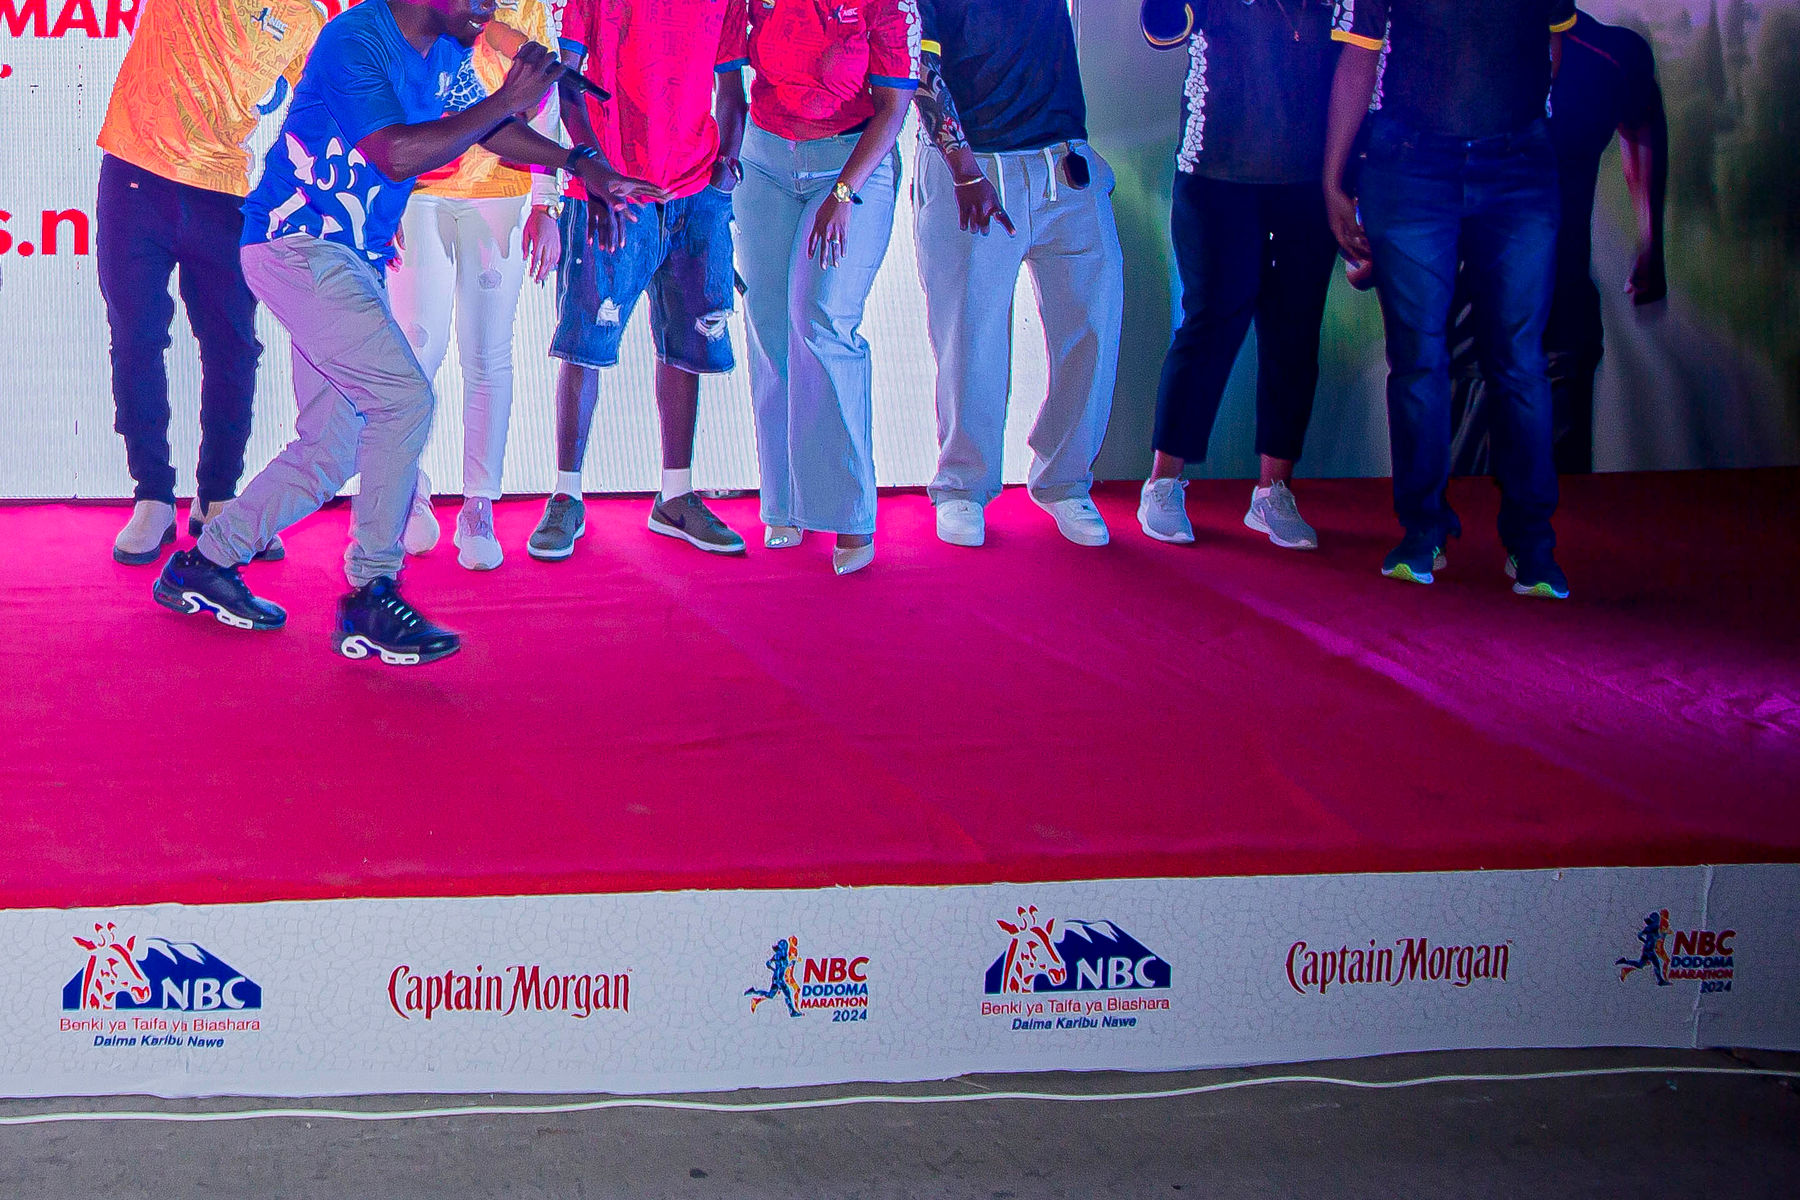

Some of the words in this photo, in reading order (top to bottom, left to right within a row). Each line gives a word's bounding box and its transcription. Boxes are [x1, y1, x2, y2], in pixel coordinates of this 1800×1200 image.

[1672, 930, 1736, 956] NBC
[803, 957, 870, 983] NBC
[1076, 956, 1157, 990] NBC
[1285, 939, 1393, 994] Captain
[1390, 937, 1512, 987] Morgan
[160, 977, 246, 1011] NBC
[388, 964, 503, 1020] Captain
[502, 964, 630, 1018] Morgan
[802, 984, 869, 996] DODOMA
[800, 996, 868, 1008] MARATHON
[981, 1002, 1022, 1015] Benki
[1026, 1004, 1043, 1017] ya
[1049, 999, 1082, 1013] Taifa
[1085, 1002, 1102, 1015] ya
[1107, 997, 1170, 1011] Biashara
[60, 1019, 104, 1031] Benki
[109, 1020, 127, 1034] ya
[131, 1017, 167, 1031] Taifa
[172, 1019, 188, 1034] ya
[193, 1018, 261, 1031] Biashara
[832, 1009, 868, 1022] 2024
[1012, 1017, 1052, 1030] Daima
[1056, 1017, 1098, 1029] Karibu
[1102, 1016, 1136, 1027] Nawe
[93, 1035, 137, 1047] Daima
[140, 1035, 183, 1047] Karibu
[187, 1035, 225, 1048] Nawe
